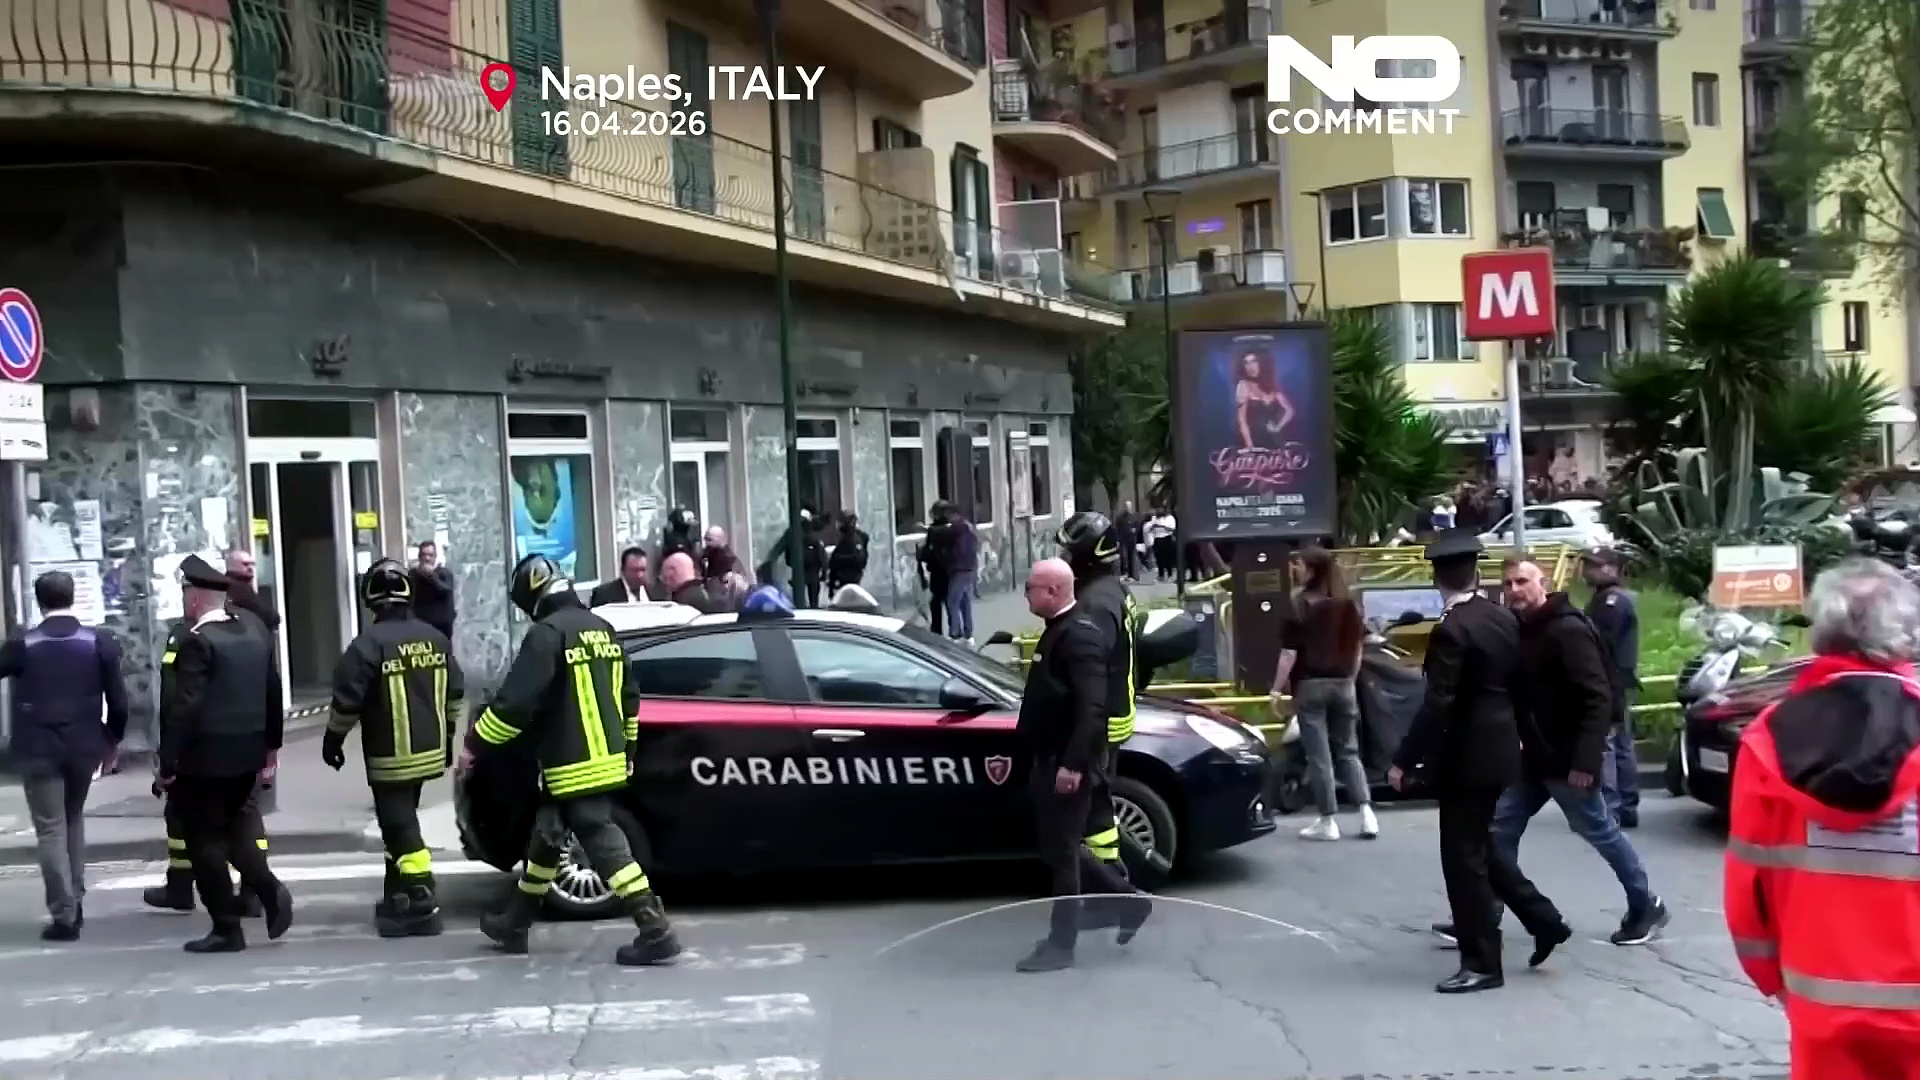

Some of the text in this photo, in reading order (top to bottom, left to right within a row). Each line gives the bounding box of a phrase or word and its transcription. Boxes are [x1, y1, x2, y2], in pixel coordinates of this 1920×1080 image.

[1479, 271, 1538, 319] M
[382, 658, 406, 674] DEL
[564, 647, 592, 664] DEL
[690, 756, 975, 786] CARABINIERI
